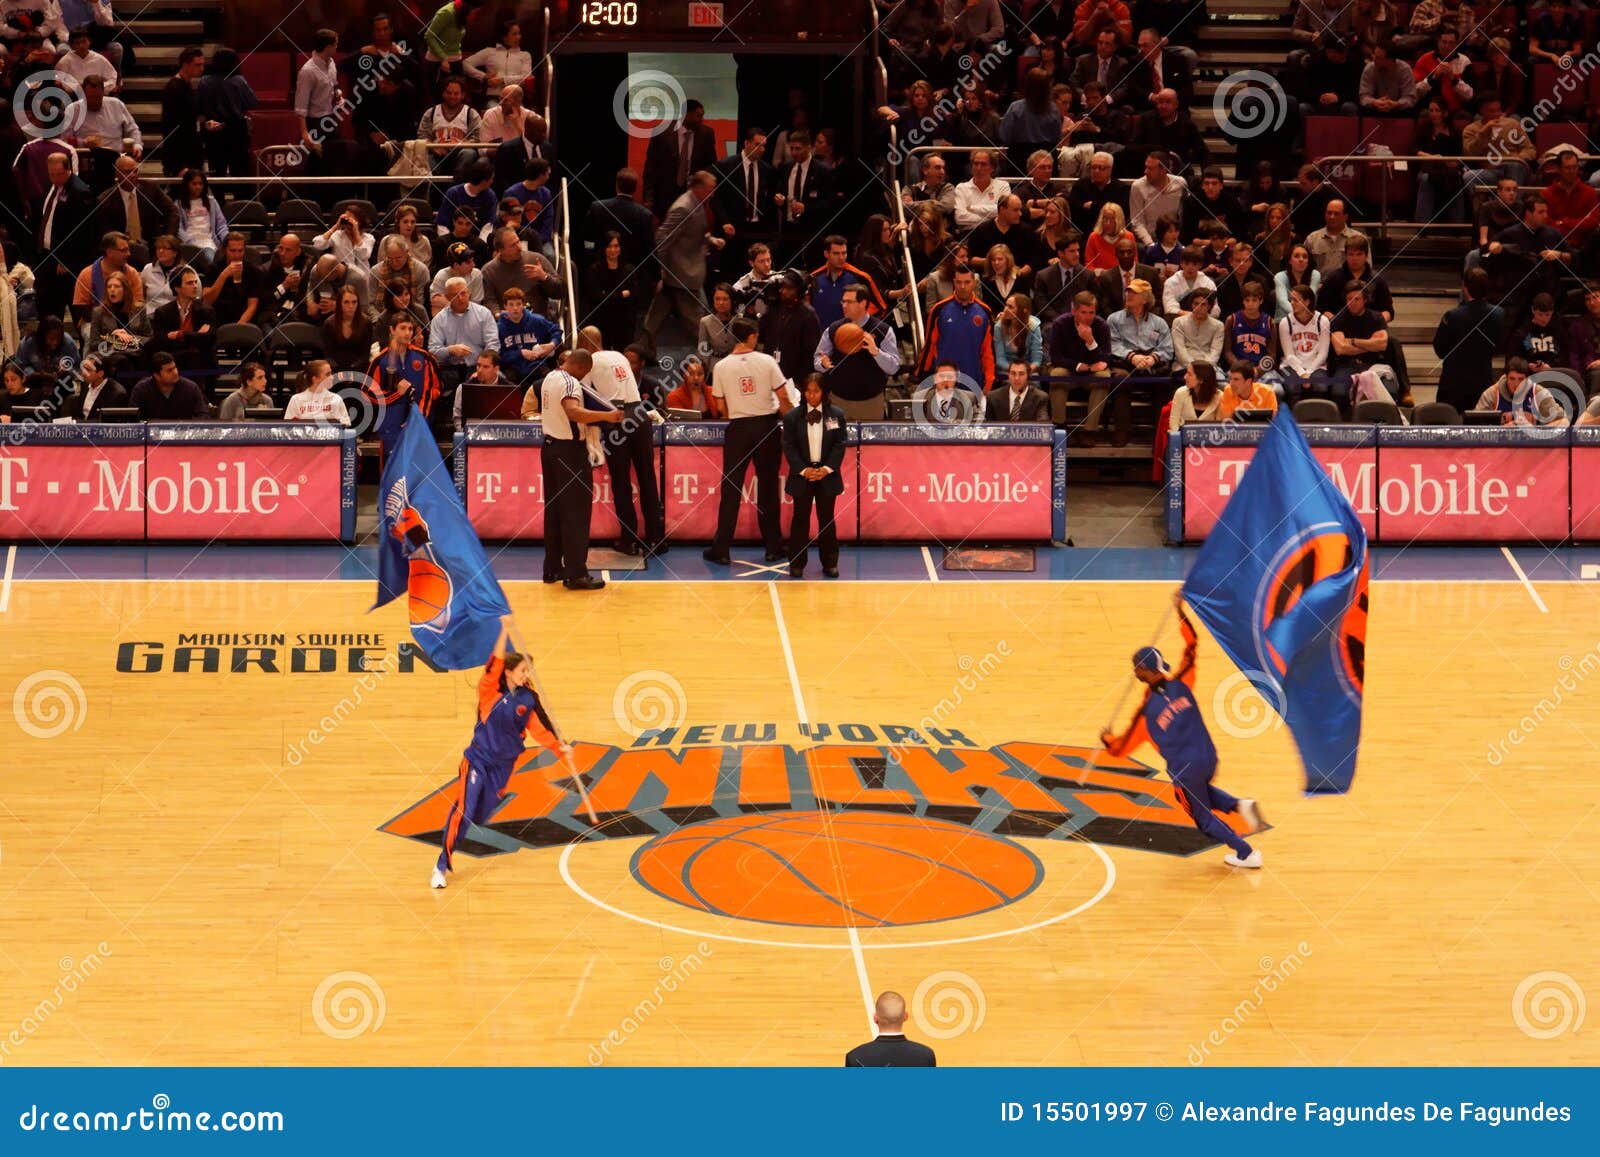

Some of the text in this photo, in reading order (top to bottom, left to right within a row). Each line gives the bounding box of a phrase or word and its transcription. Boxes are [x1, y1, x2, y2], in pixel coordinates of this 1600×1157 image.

[582, 2, 638, 25] 12:00
[692, 6, 719, 25] EXIT
[1243, 341, 1260, 355] 34
[177, 633, 385, 646] MADISON SQUARE
[116, 641, 449, 674] GARDEN
[631, 723, 977, 747] NEW YORK
[379, 740, 1273, 857] KNICKS
